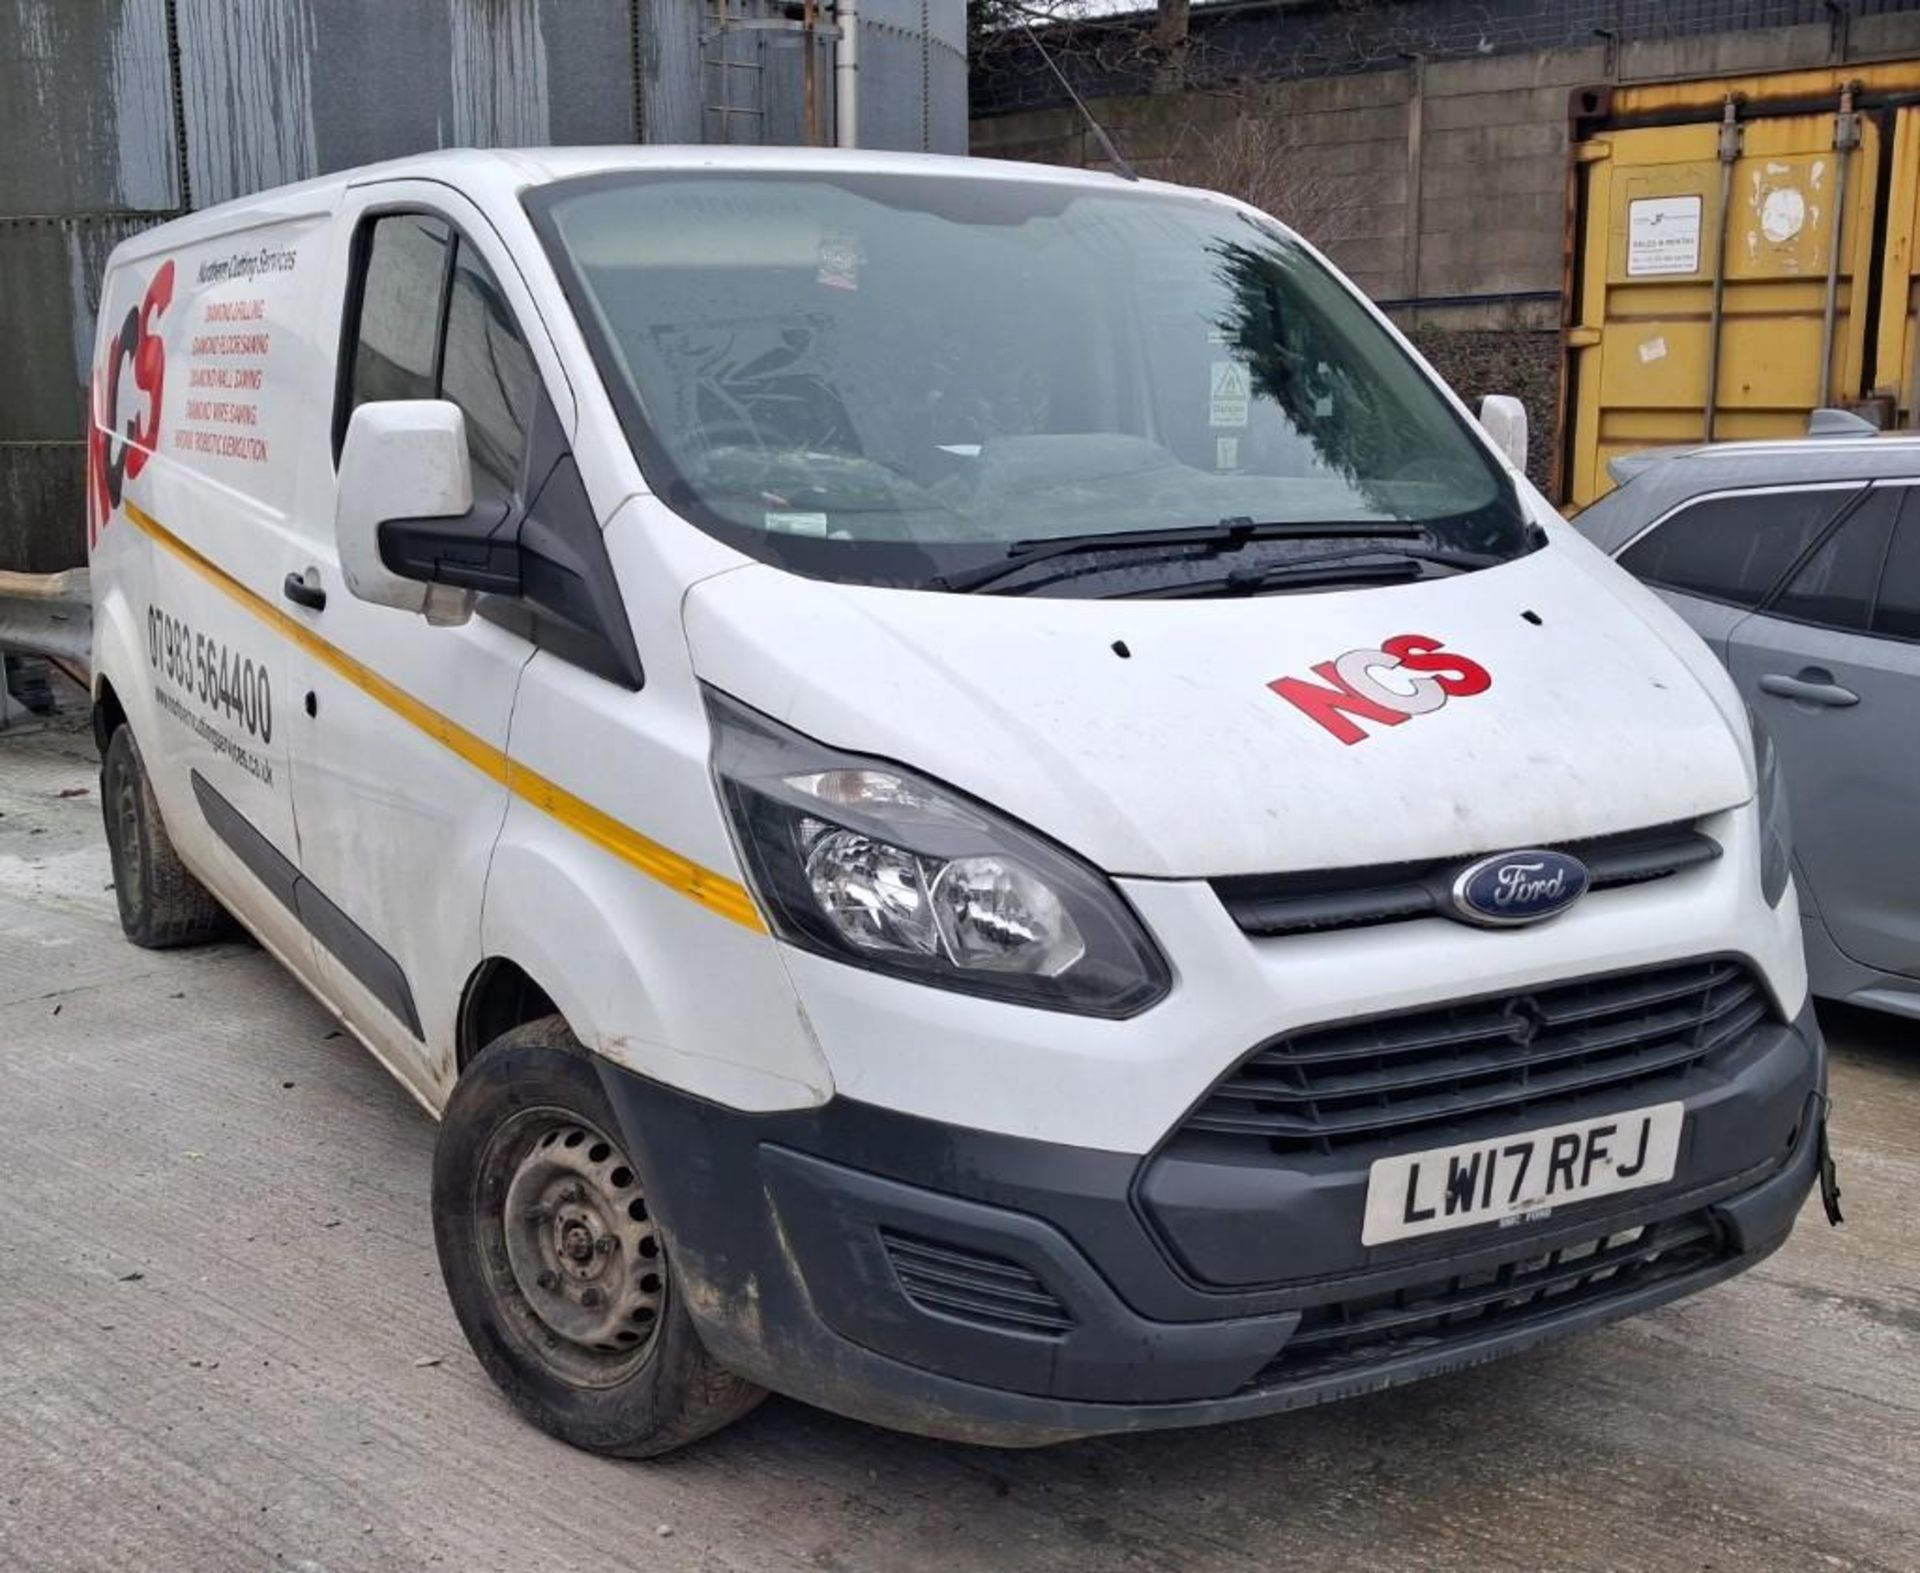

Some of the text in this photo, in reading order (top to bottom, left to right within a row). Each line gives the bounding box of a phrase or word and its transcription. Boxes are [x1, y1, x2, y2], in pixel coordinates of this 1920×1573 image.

[257, 247, 297, 274] Services
[148, 604, 272, 745] 07983 564400
[1266, 634, 1492, 746] NCS
[1494, 863, 1567, 905] Ford
[1403, 1116, 1652, 1224] LW17 RFJ
